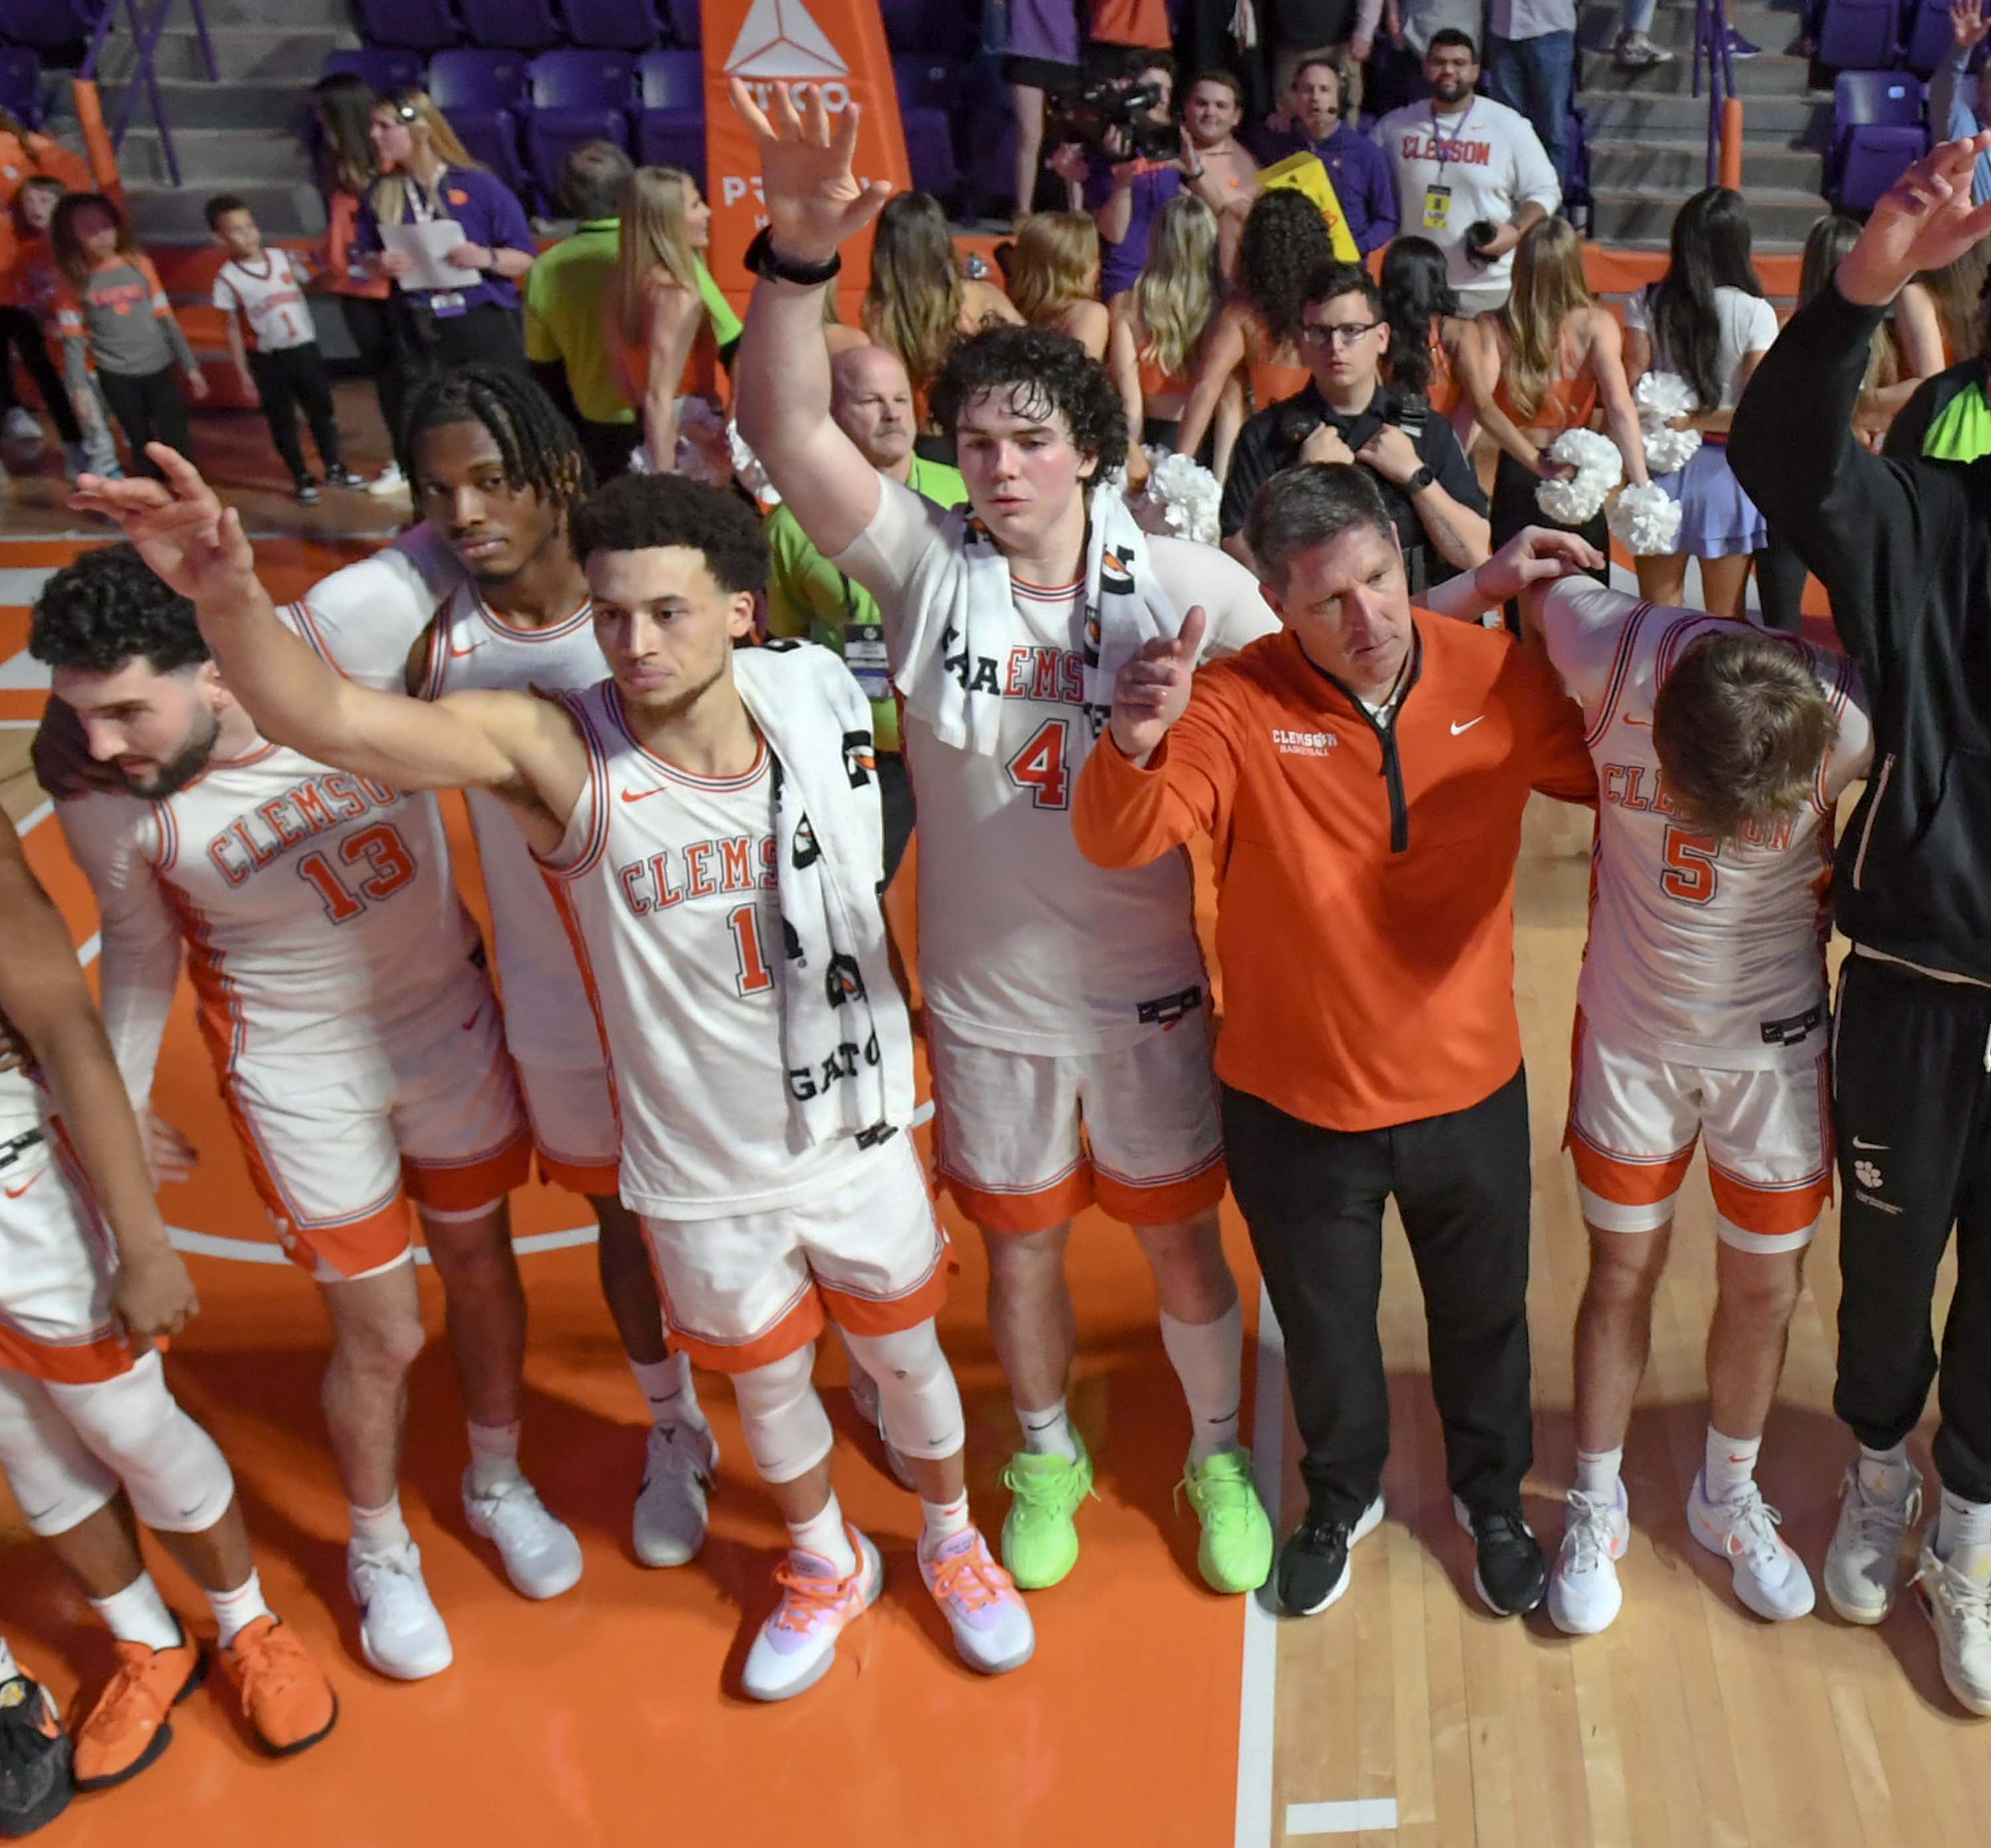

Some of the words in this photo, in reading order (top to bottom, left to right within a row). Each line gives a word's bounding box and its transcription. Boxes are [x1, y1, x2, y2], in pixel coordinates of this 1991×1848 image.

[281, 311, 298, 338] 1
[1005, 718, 1070, 810] 4
[1272, 730, 1338, 747] CLEMSON
[206, 772, 401, 889] CLEMSO
[1601, 763, 1797, 851] CLEON
[297, 821, 417, 925] 13
[618, 834, 779, 917] CLEMS
[1660, 824, 1720, 905] 5
[727, 902, 774, 997] 1
